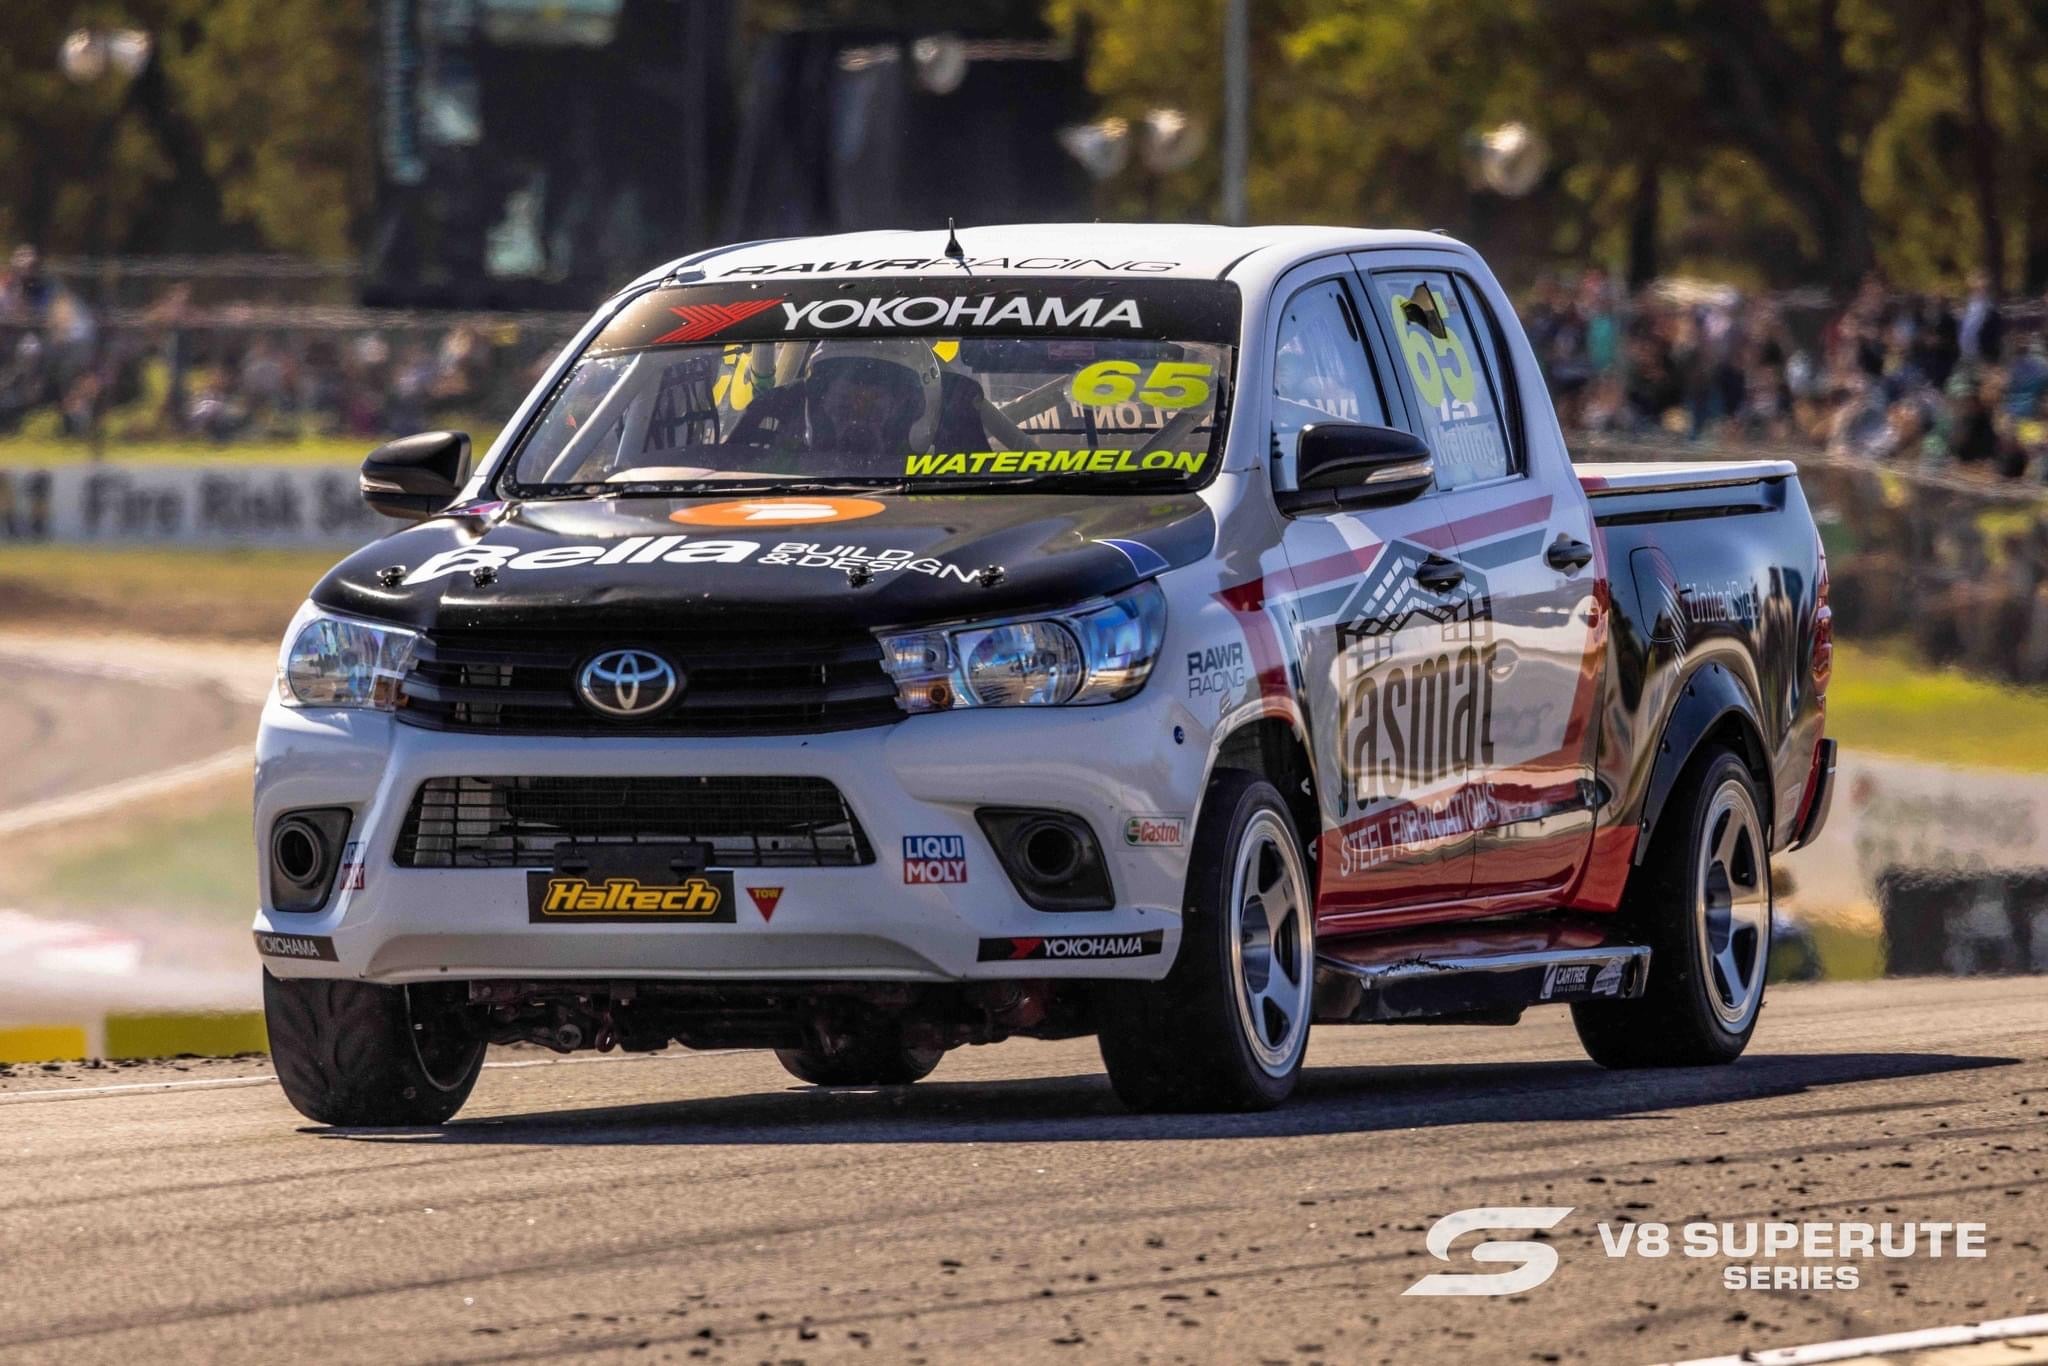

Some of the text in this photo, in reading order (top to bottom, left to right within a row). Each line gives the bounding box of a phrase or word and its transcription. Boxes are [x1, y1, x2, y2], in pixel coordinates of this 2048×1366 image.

[780, 297, 1144, 330] YOKOHAMA
[1070, 359, 1213, 409] 65
[904, 449, 1208, 476] WATERMELON
[403, 535, 913, 586] Bella BUILD
[1187, 642, 1244, 677] RAWR
[1187, 667, 1246, 699] RACING
[1141, 819, 1181, 843] Castrol
[1340, 782, 1499, 877] STEEL FABRICATIONS
[906, 837, 963, 861] LIQUI
[906, 862, 966, 884] MOLY
[543, 878, 721, 915] Haltech
[754, 889, 780, 899] TOW
[1043, 936, 1143, 957] YOKOHAMA
